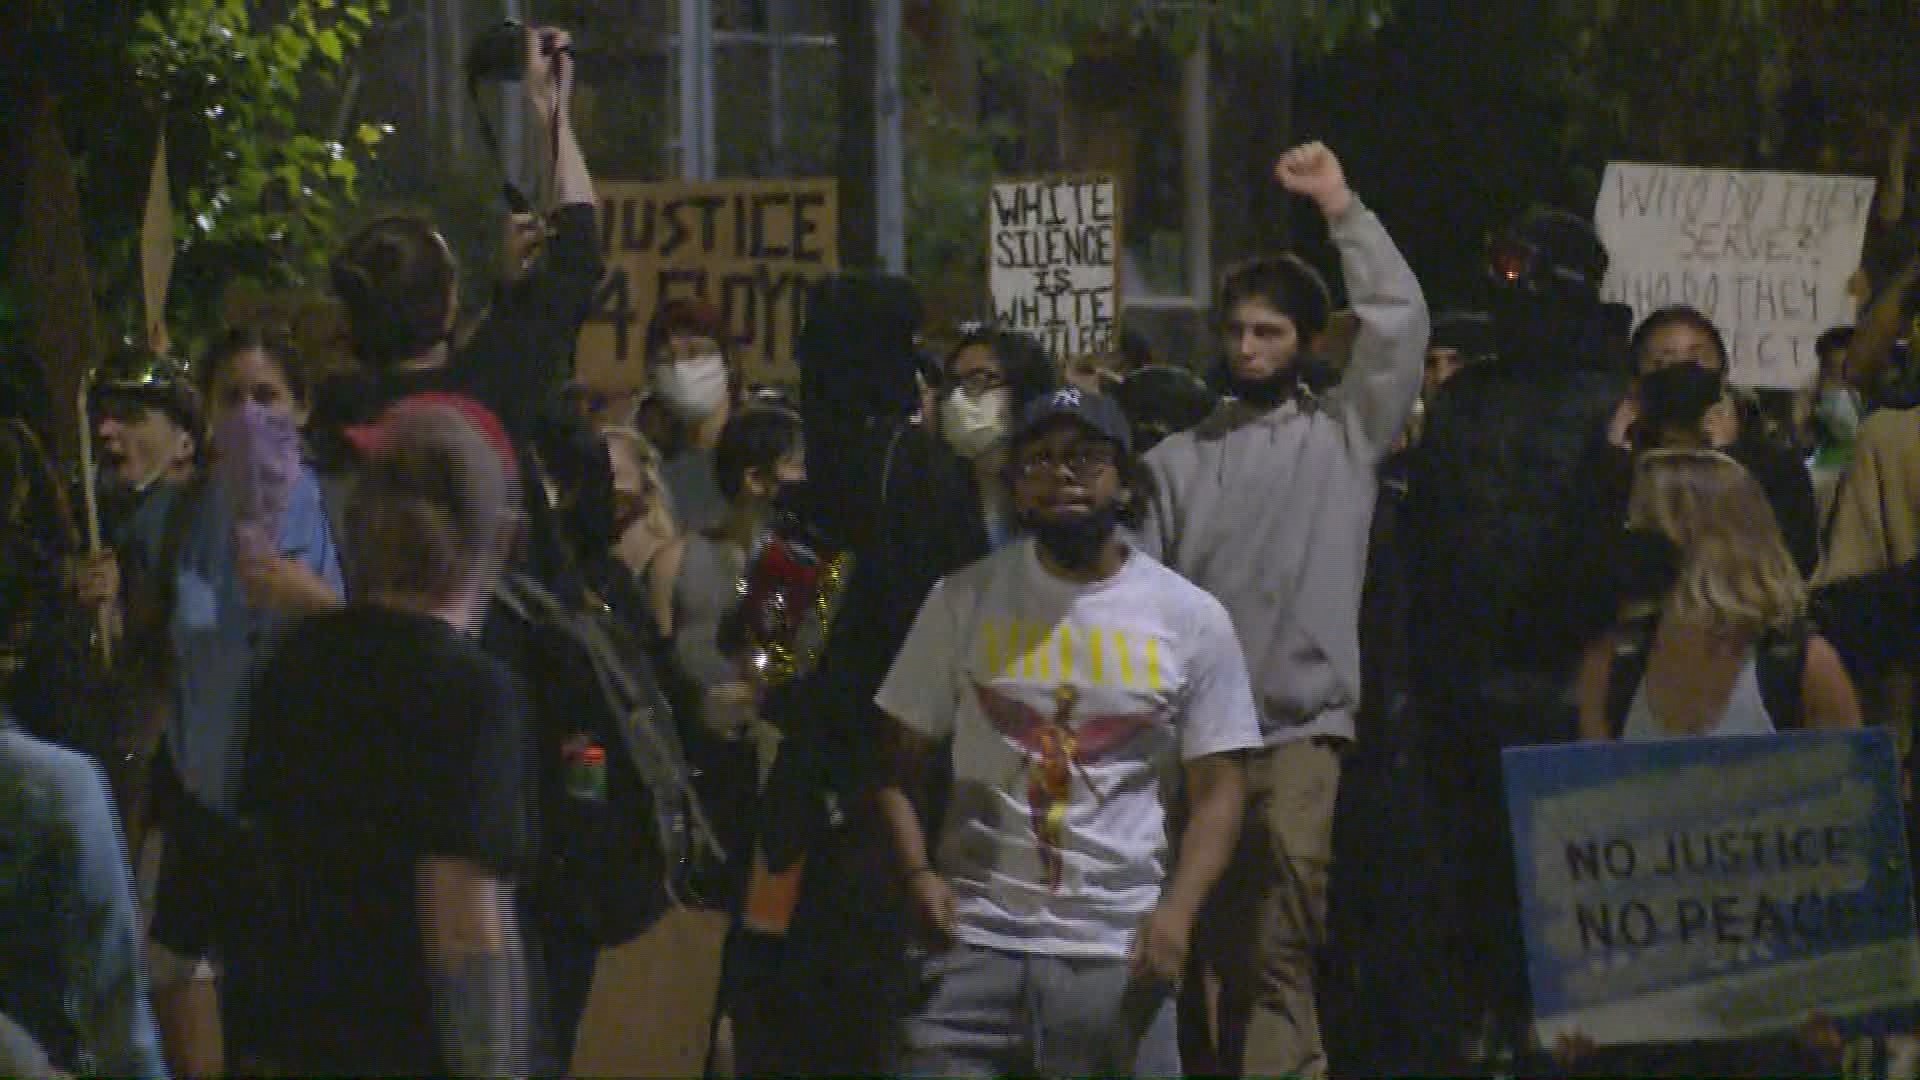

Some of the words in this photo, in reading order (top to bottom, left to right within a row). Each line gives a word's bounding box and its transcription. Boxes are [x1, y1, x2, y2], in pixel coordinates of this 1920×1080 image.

[600, 191, 825, 262] JUSTICE
[992, 180, 1114, 226] WHITE
[997, 225, 1114, 268] SILENCE
[1034, 268, 1072, 295] IS
[1730, 274, 1819, 321] THEY
[587, 265, 636, 361] 4
[992, 286, 1114, 328] WHITE
[1565, 838, 1637, 882] NO
[1653, 826, 1851, 877] JUSTICE
[1576, 900, 1658, 951] NO
